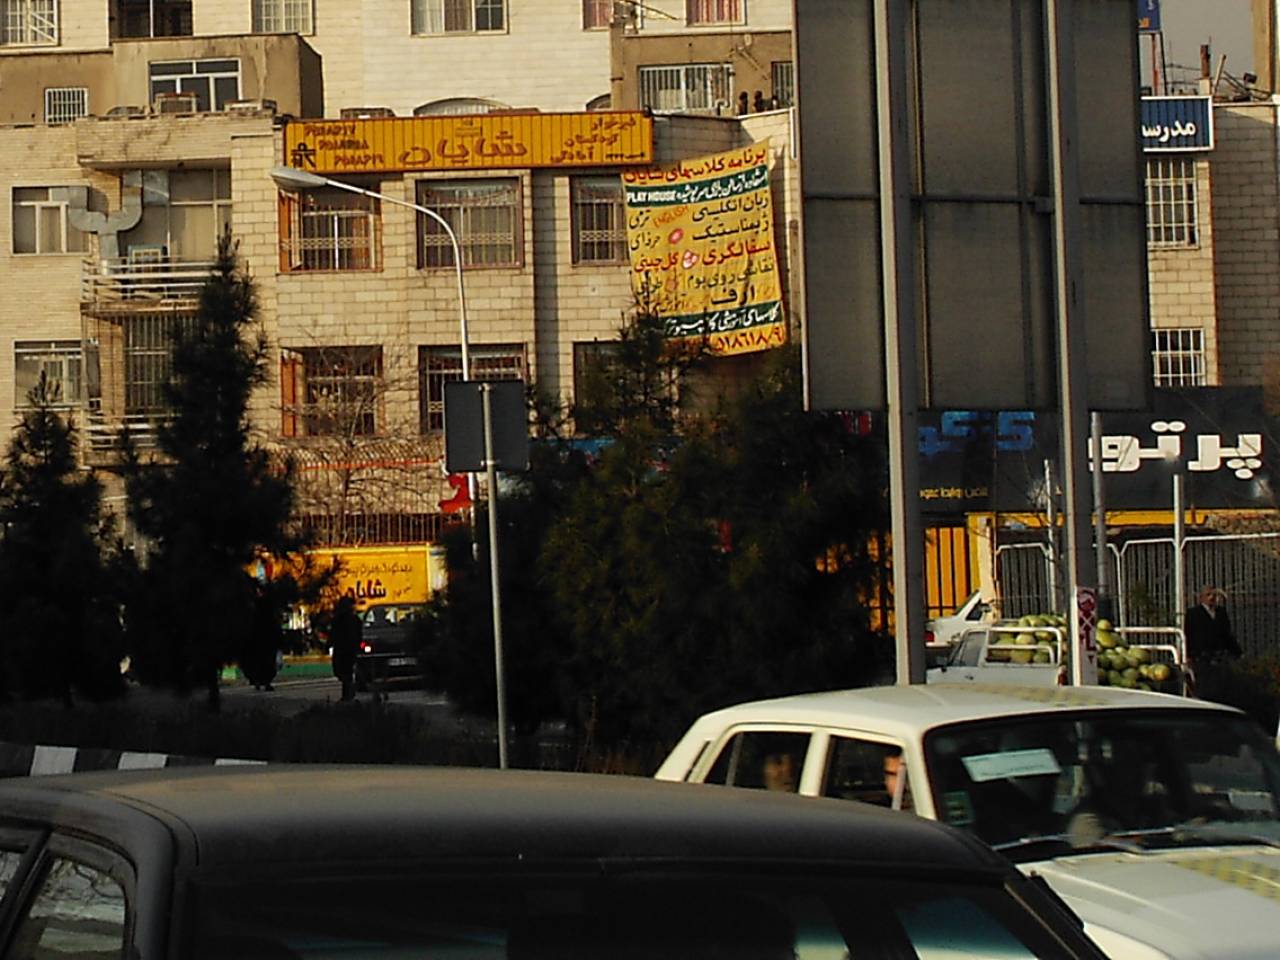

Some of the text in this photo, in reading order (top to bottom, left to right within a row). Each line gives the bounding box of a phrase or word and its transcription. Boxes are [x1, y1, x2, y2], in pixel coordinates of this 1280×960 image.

[1141, 120, 1196, 143] مدرس
[399, 126, 528, 166] شایان
[727, 147, 766, 168] برنامه
[624, 167, 664, 185] شایان
[692, 199, 743, 222] انگلیسی
[743, 191, 769, 213] زبان
[692, 214, 769, 242] ژیمناستیک
[702, 238, 771, 266] سفالگری
[1088, 421, 1262, 480] پرتو
